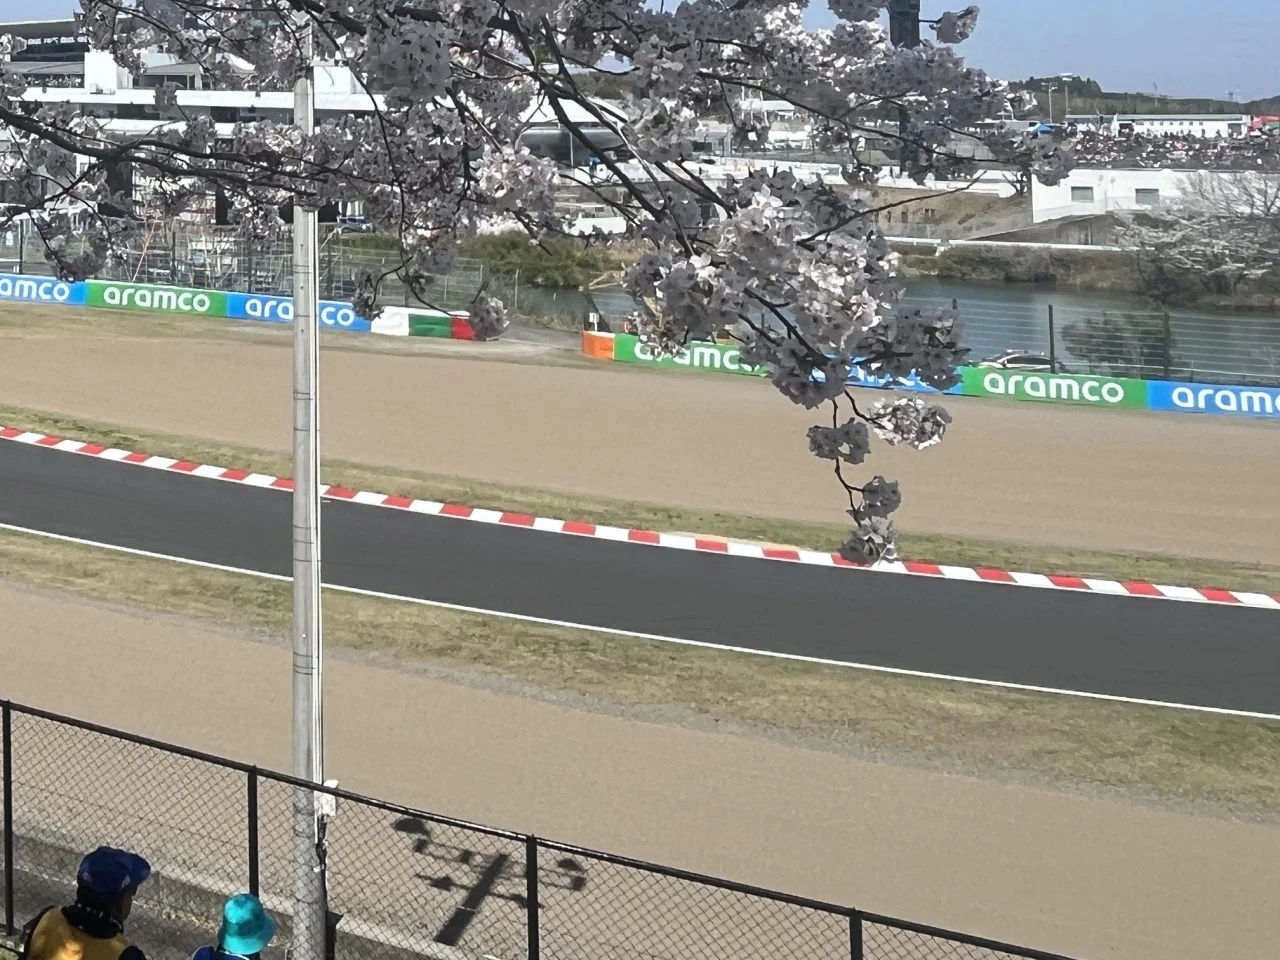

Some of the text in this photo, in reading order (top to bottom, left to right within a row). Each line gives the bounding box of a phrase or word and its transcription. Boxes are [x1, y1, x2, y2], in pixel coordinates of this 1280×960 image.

[103, 286, 210, 312] aramco
[245, 298, 355, 326] araco
[983, 373, 1124, 403] aramco
[1172, 387, 1280, 413] aram
